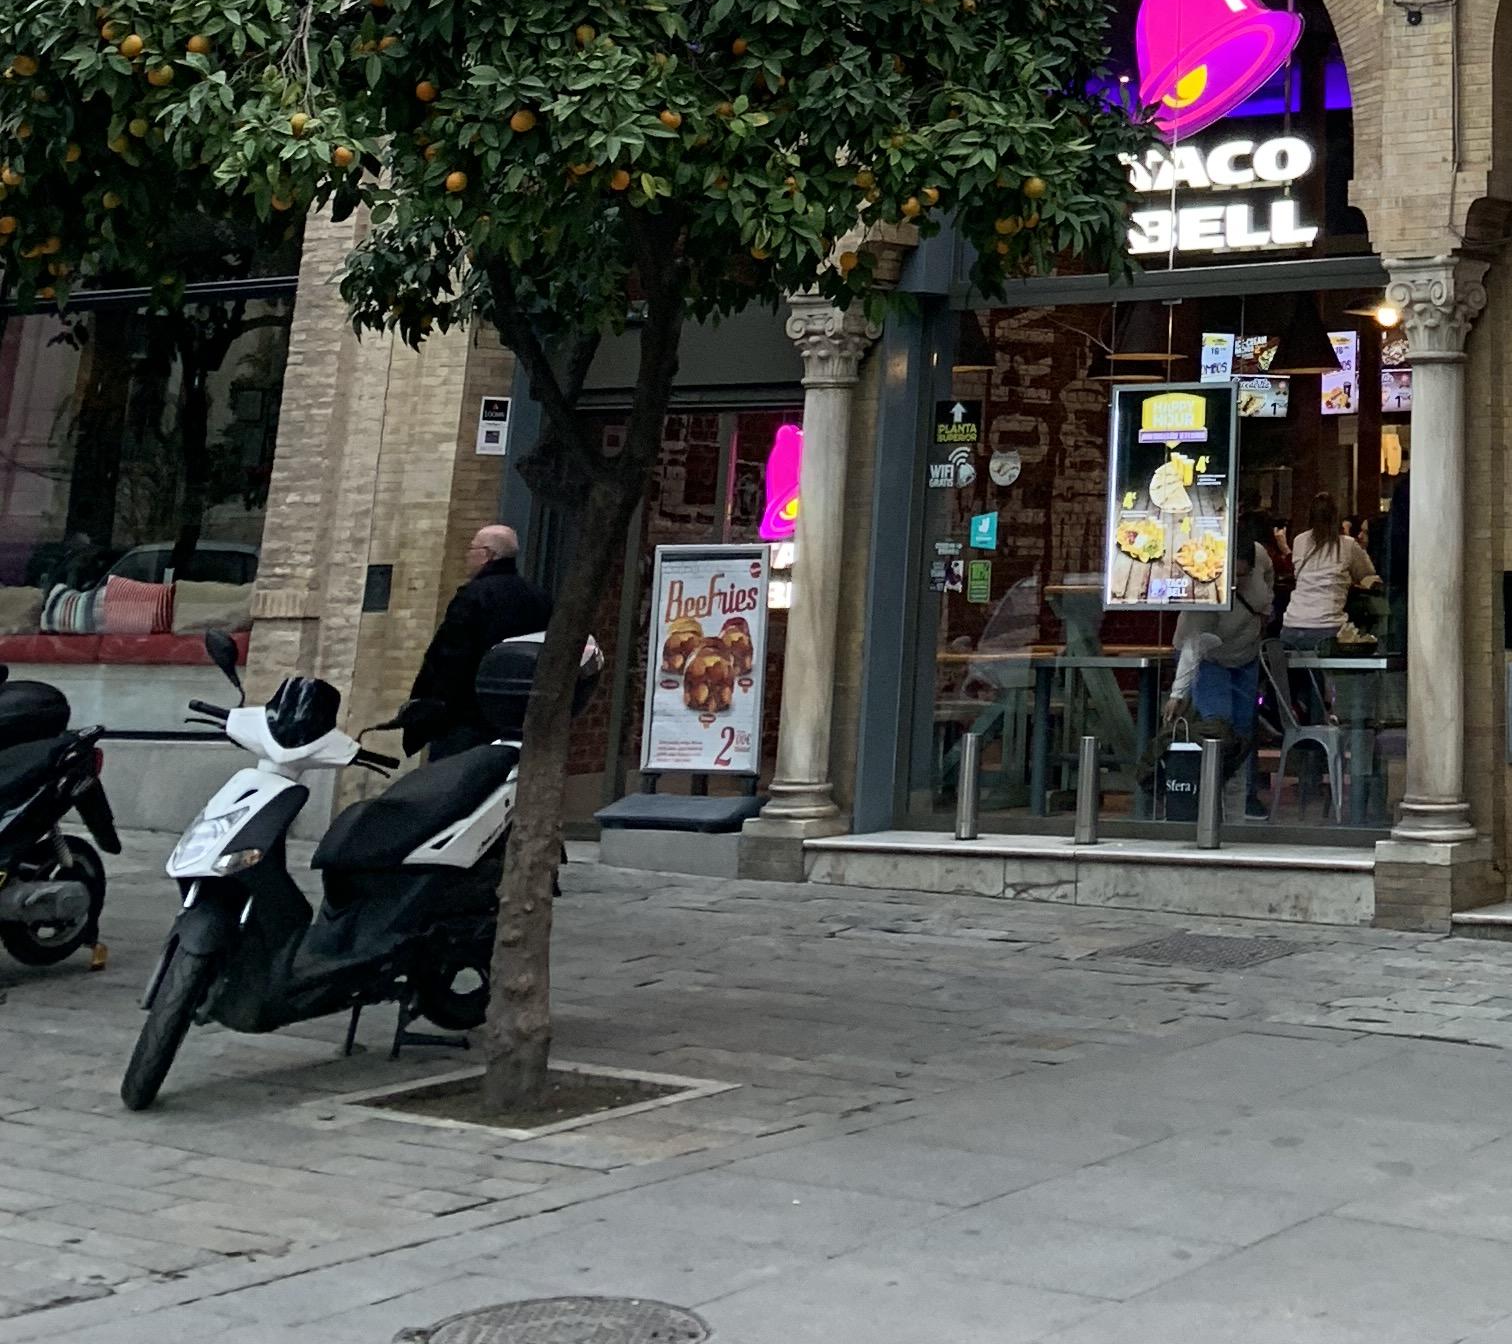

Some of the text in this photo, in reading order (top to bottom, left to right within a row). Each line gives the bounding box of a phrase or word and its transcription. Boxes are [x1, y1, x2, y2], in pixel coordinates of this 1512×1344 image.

[1127, 199, 1319, 255] BELL
[937, 423, 977, 434] PLANTA
[929, 464, 954, 479] WIFI
[714, 725, 736, 767] 2
[1166, 779, 1191, 792] Sfera
